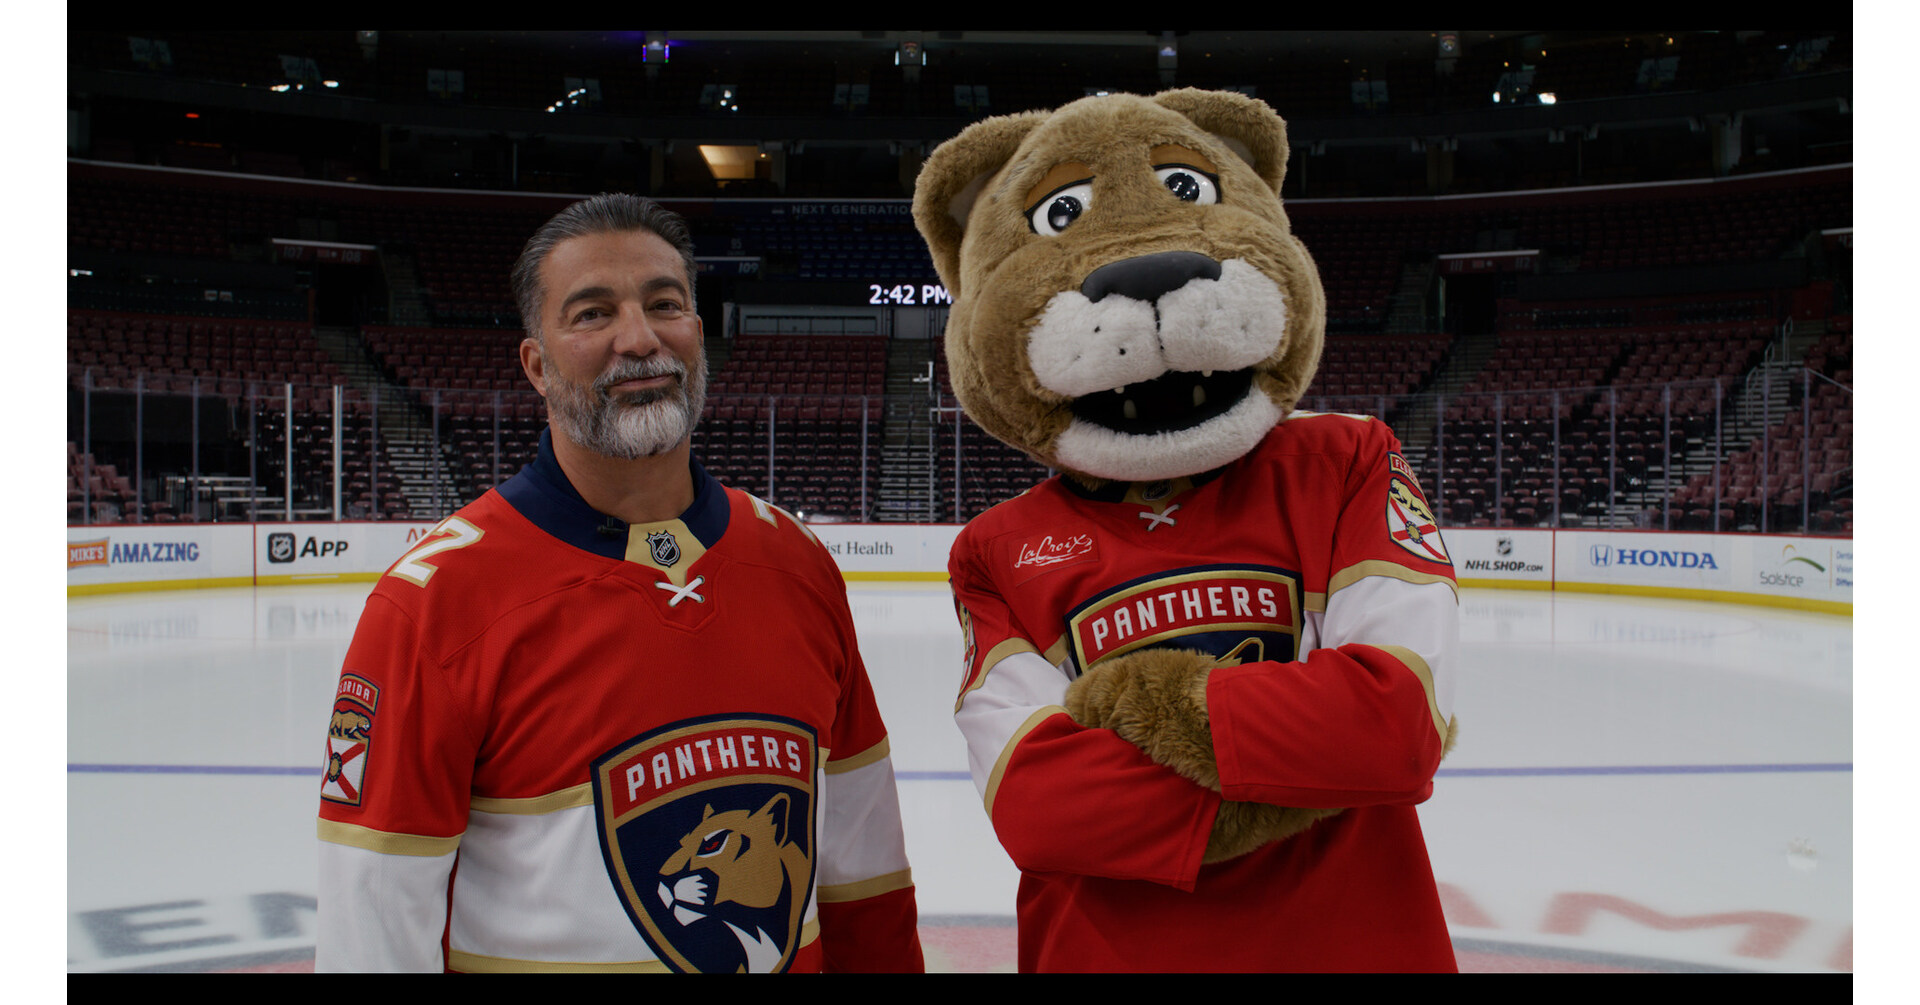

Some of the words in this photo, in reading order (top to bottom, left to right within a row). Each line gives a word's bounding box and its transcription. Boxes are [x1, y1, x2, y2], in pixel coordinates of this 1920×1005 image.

[792, 204, 826, 216] NEXT
[831, 204, 913, 216] GENERATIO
[283, 246, 303, 260] 107
[738, 262, 759, 274] 109
[869, 284, 915, 305] 2:42
[921, 284, 952, 305] PM
[70, 545, 105, 562] MIKE'S
[111, 542, 200, 563] AMAZING
[826, 540, 842, 555] ist
[847, 541, 894, 556] Health
[1616, 549, 1719, 570] HONDA
[1091, 586, 1278, 651] PANTHERS
[626, 735, 802, 803] PANTHERS
